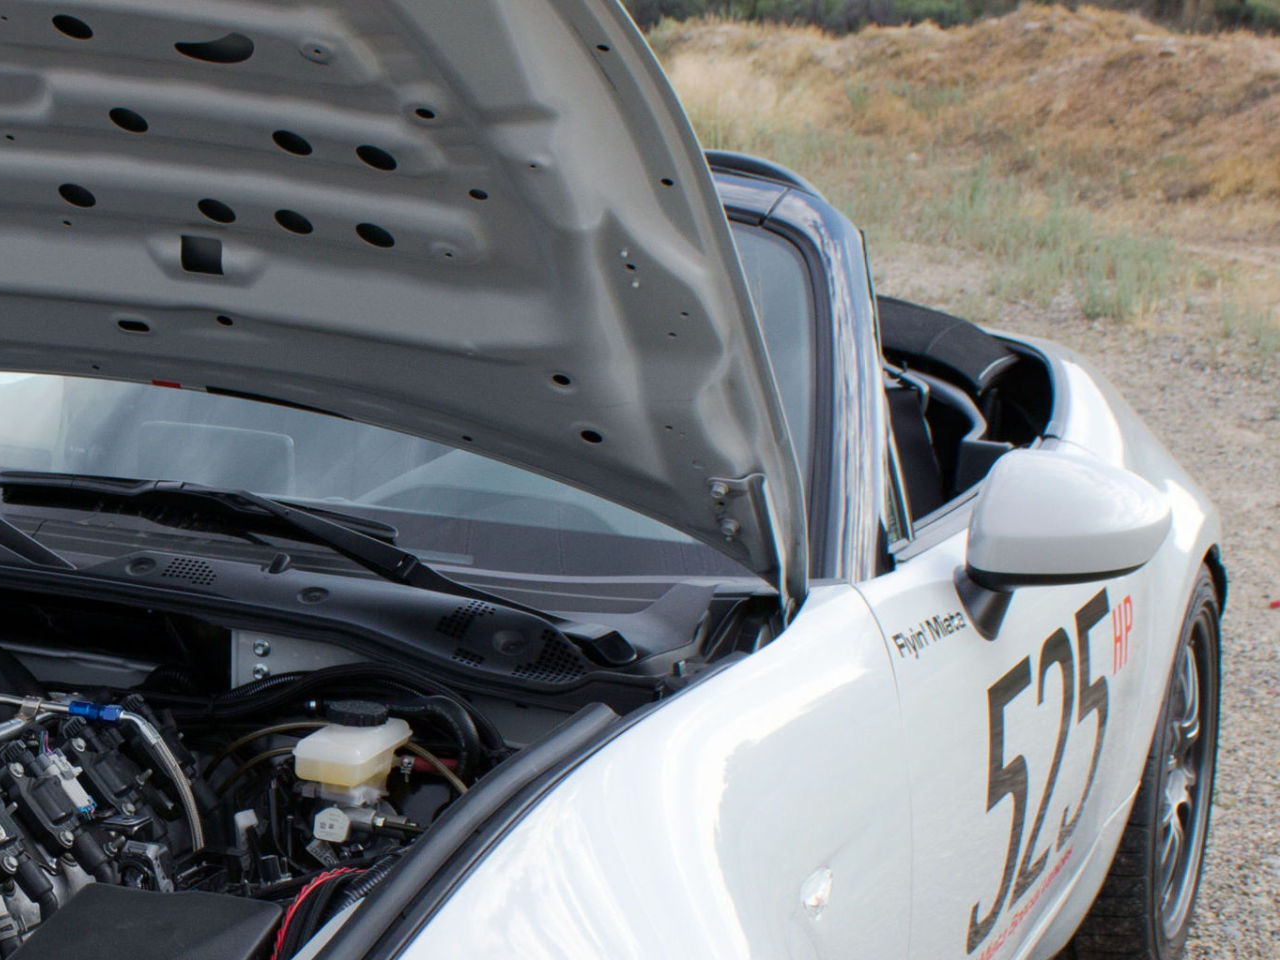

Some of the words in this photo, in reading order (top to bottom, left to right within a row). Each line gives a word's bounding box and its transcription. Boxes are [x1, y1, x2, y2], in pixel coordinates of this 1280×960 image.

[892, 622, 929, 659] Flyin'
[925, 611, 966, 641] Miata
[966, 587, 1111, 955] 525
[1112, 595, 1133, 675] HP
